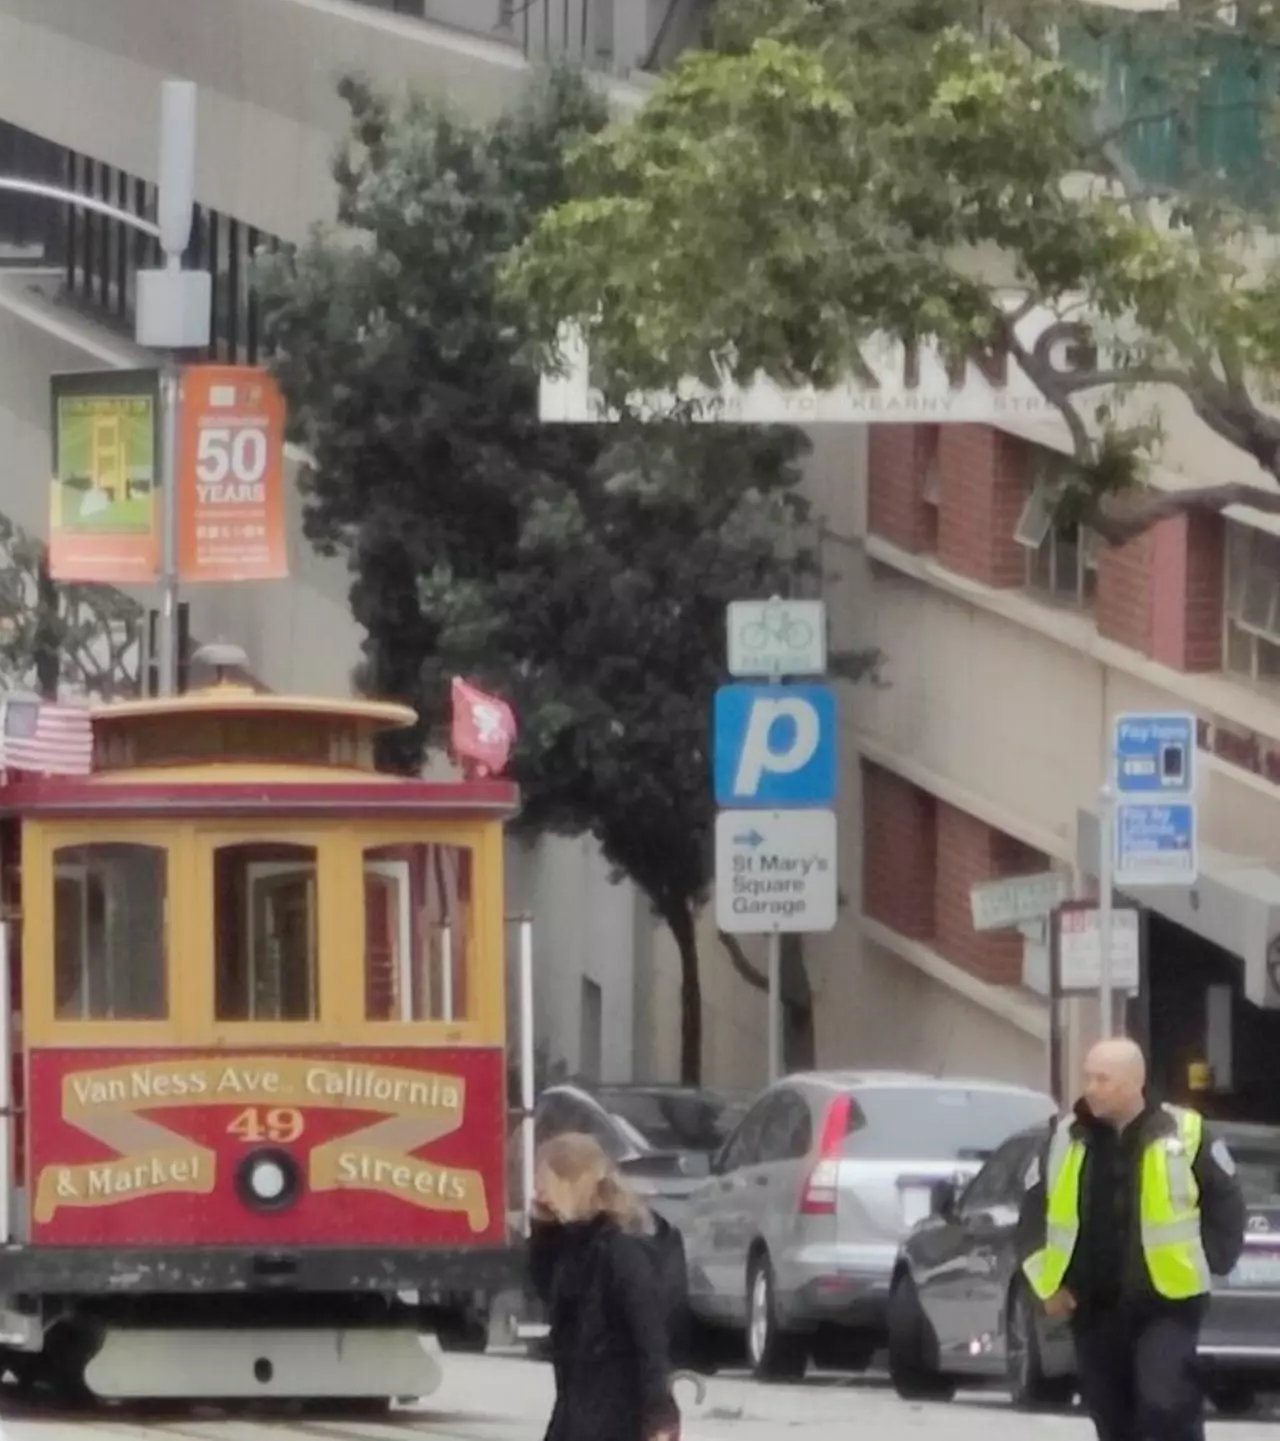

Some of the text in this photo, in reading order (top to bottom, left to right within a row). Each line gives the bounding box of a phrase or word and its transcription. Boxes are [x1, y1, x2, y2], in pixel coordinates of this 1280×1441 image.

[196, 428, 267, 482] 50
[195, 484, 266, 503] YEARS
[760, 854, 829, 877] Mary's
[732, 875, 806, 897] Square
[732, 896, 806, 918] Garage
[72, 1078, 125, 1106] Van
[131, 1069, 207, 1098] Ness
[306, 1067, 460, 1109] California
[226, 1107, 304, 1143] 49
[56, 1156, 200, 1197] & Market
[338, 1152, 466, 1198] Streets
